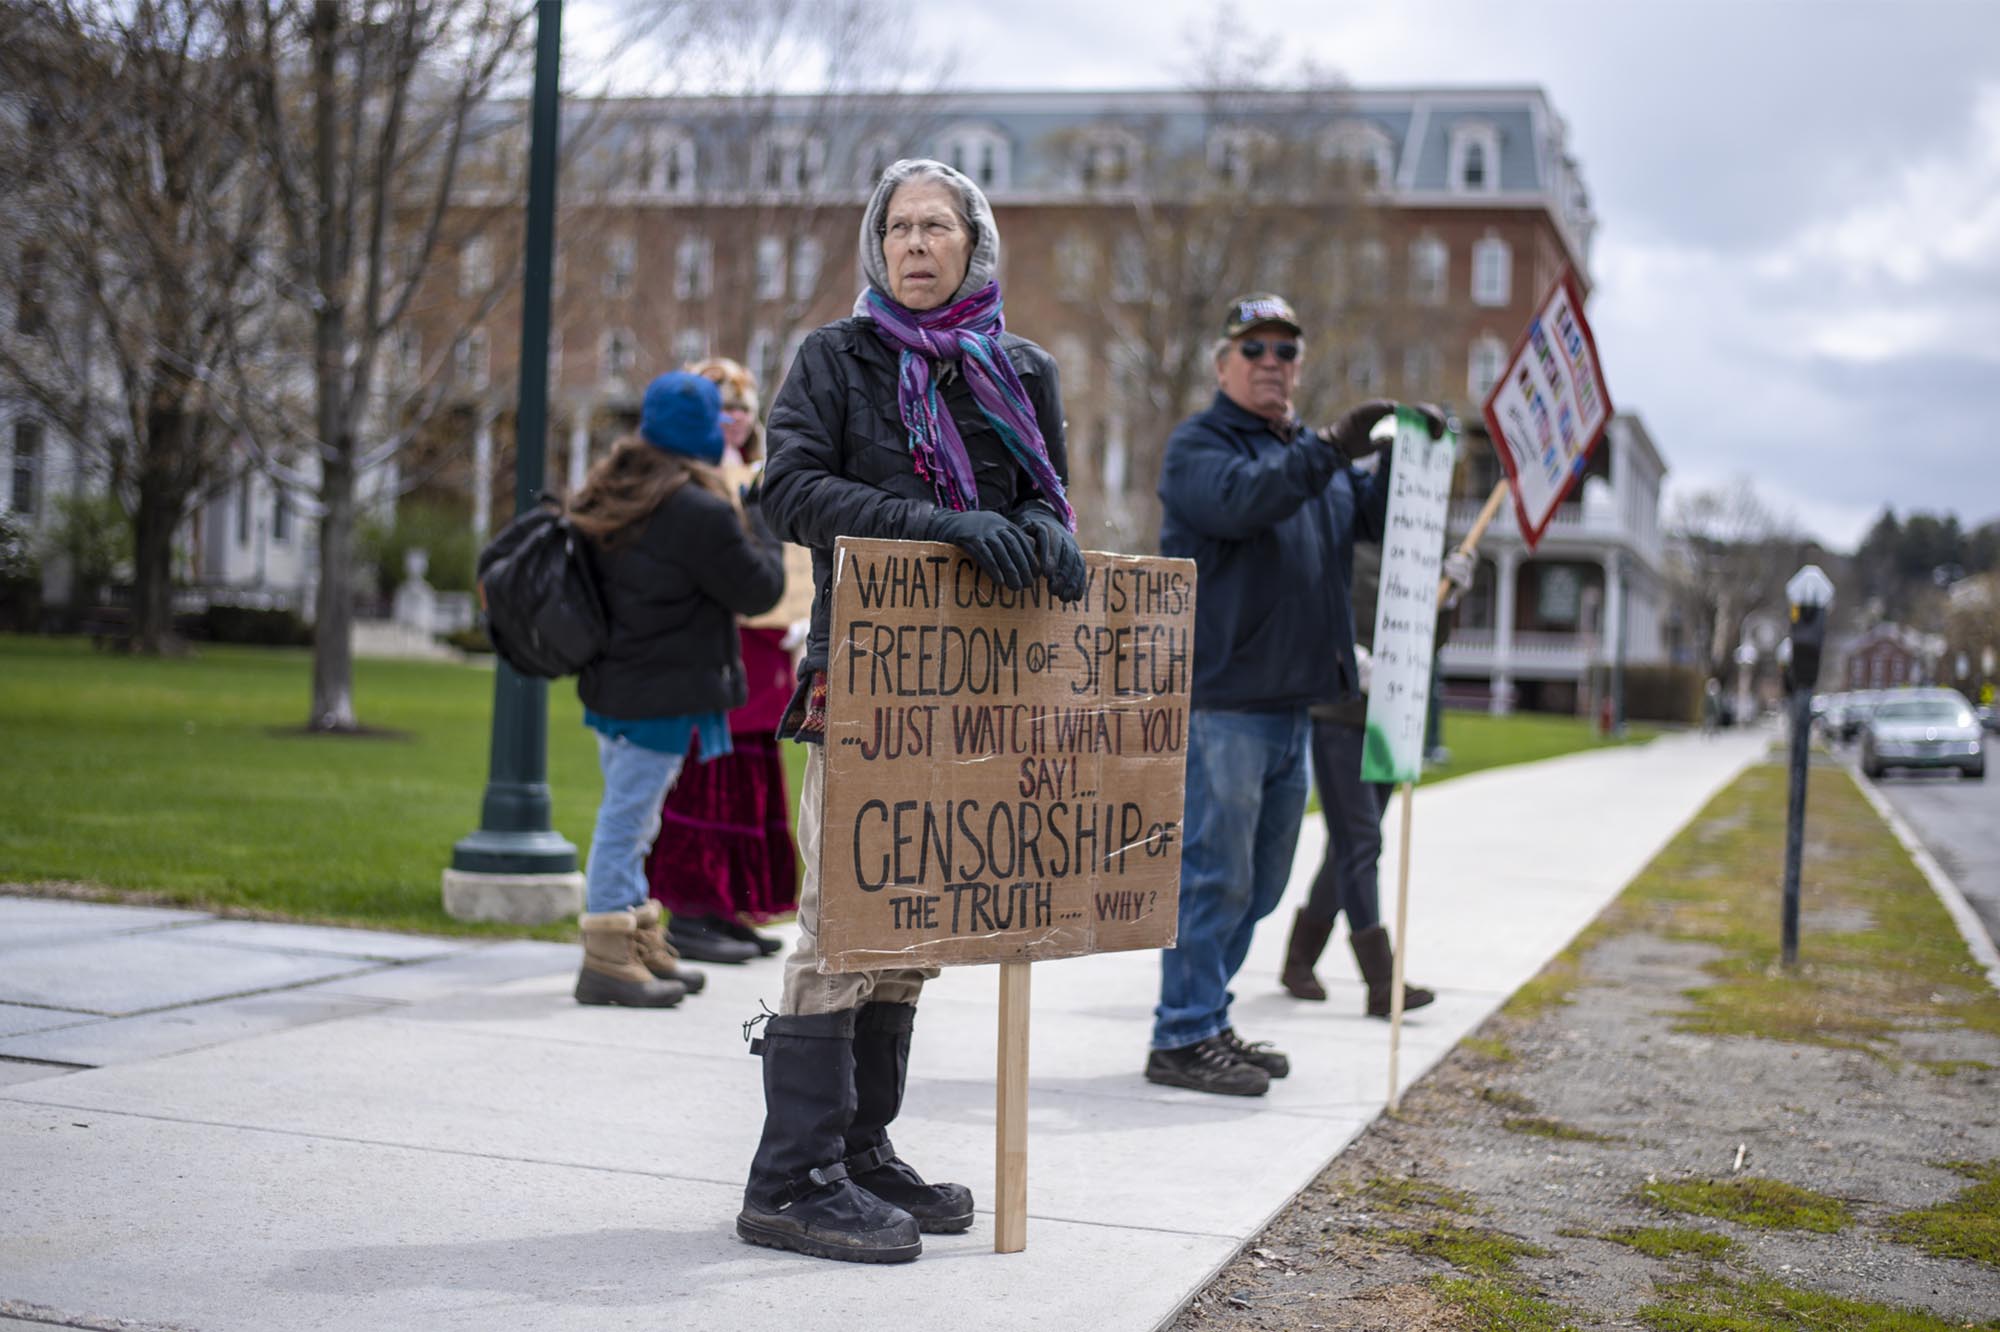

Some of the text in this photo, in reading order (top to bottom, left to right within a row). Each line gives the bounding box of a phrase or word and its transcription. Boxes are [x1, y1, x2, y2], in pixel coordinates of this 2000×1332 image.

[852, 554, 949, 609] WHAT
[1103, 570, 1127, 614] IS
[1129, 570, 1191, 615] THIS?
[848, 621, 1186, 696] FREEDOM OF SPEECH
[952, 704, 1046, 755] WATCH
[1054, 707, 1128, 755] WHAT
[1138, 707, 1182, 754] YOU
[853, 799, 1176, 893] CENSORSHIP OF
[889, 896, 941, 930] THE
[1095, 890, 1157, 921] WHY?
